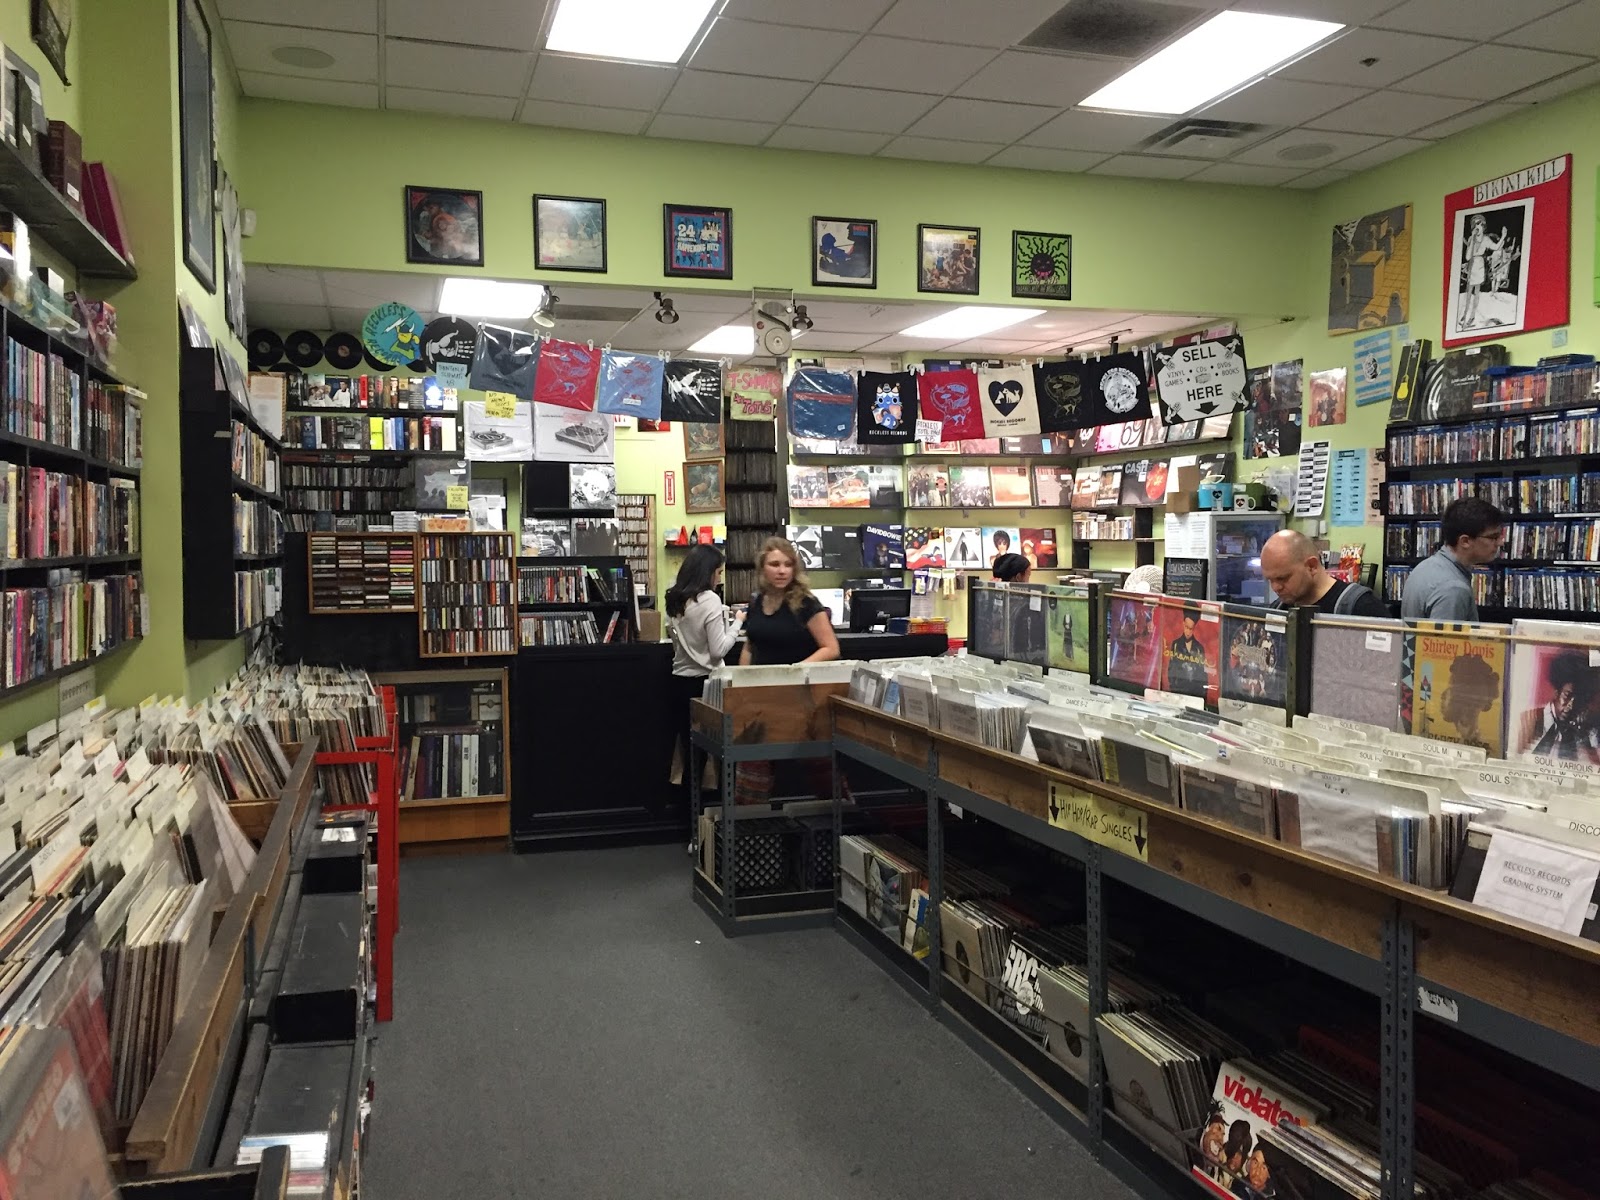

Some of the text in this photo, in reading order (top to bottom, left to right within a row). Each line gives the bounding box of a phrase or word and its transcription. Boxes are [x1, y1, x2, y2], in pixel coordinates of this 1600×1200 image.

[1526, 160, 1562, 186] KILL
[678, 224, 696, 238] 24
[365, 305, 407, 337] RECKLESS
[1182, 346, 1216, 362] SELL
[1164, 367, 1240, 388] GAMES BOOKS
[1167, 362, 1232, 378] VINYL CDs DVDs
[1186, 384, 1223, 402] HERE
[1124, 462, 1148, 474] CASH
[1422, 638, 1495, 659] Shirley Davis
[1066, 698, 1080, 706] DANCE
[1340, 722, 1354, 730] SOUL
[1359, 752, 1374, 761] SOUL
[1422, 744, 1440, 753] SOUL
[1457, 750, 1462, 758] N
[1262, 756, 1278, 768] SOUL
[1534, 756, 1594, 773] SOUL VARIOUS
[1480, 772, 1510, 785] SOUL S
[1060, 799, 1071, 820] HIP
[1100, 814, 1132, 842] SINGLES
[1569, 822, 1600, 836] DISCO
[1504, 860, 1572, 886] RECKLESS RECORDS
[1503, 876, 1564, 899] GRADING SYSTEM
